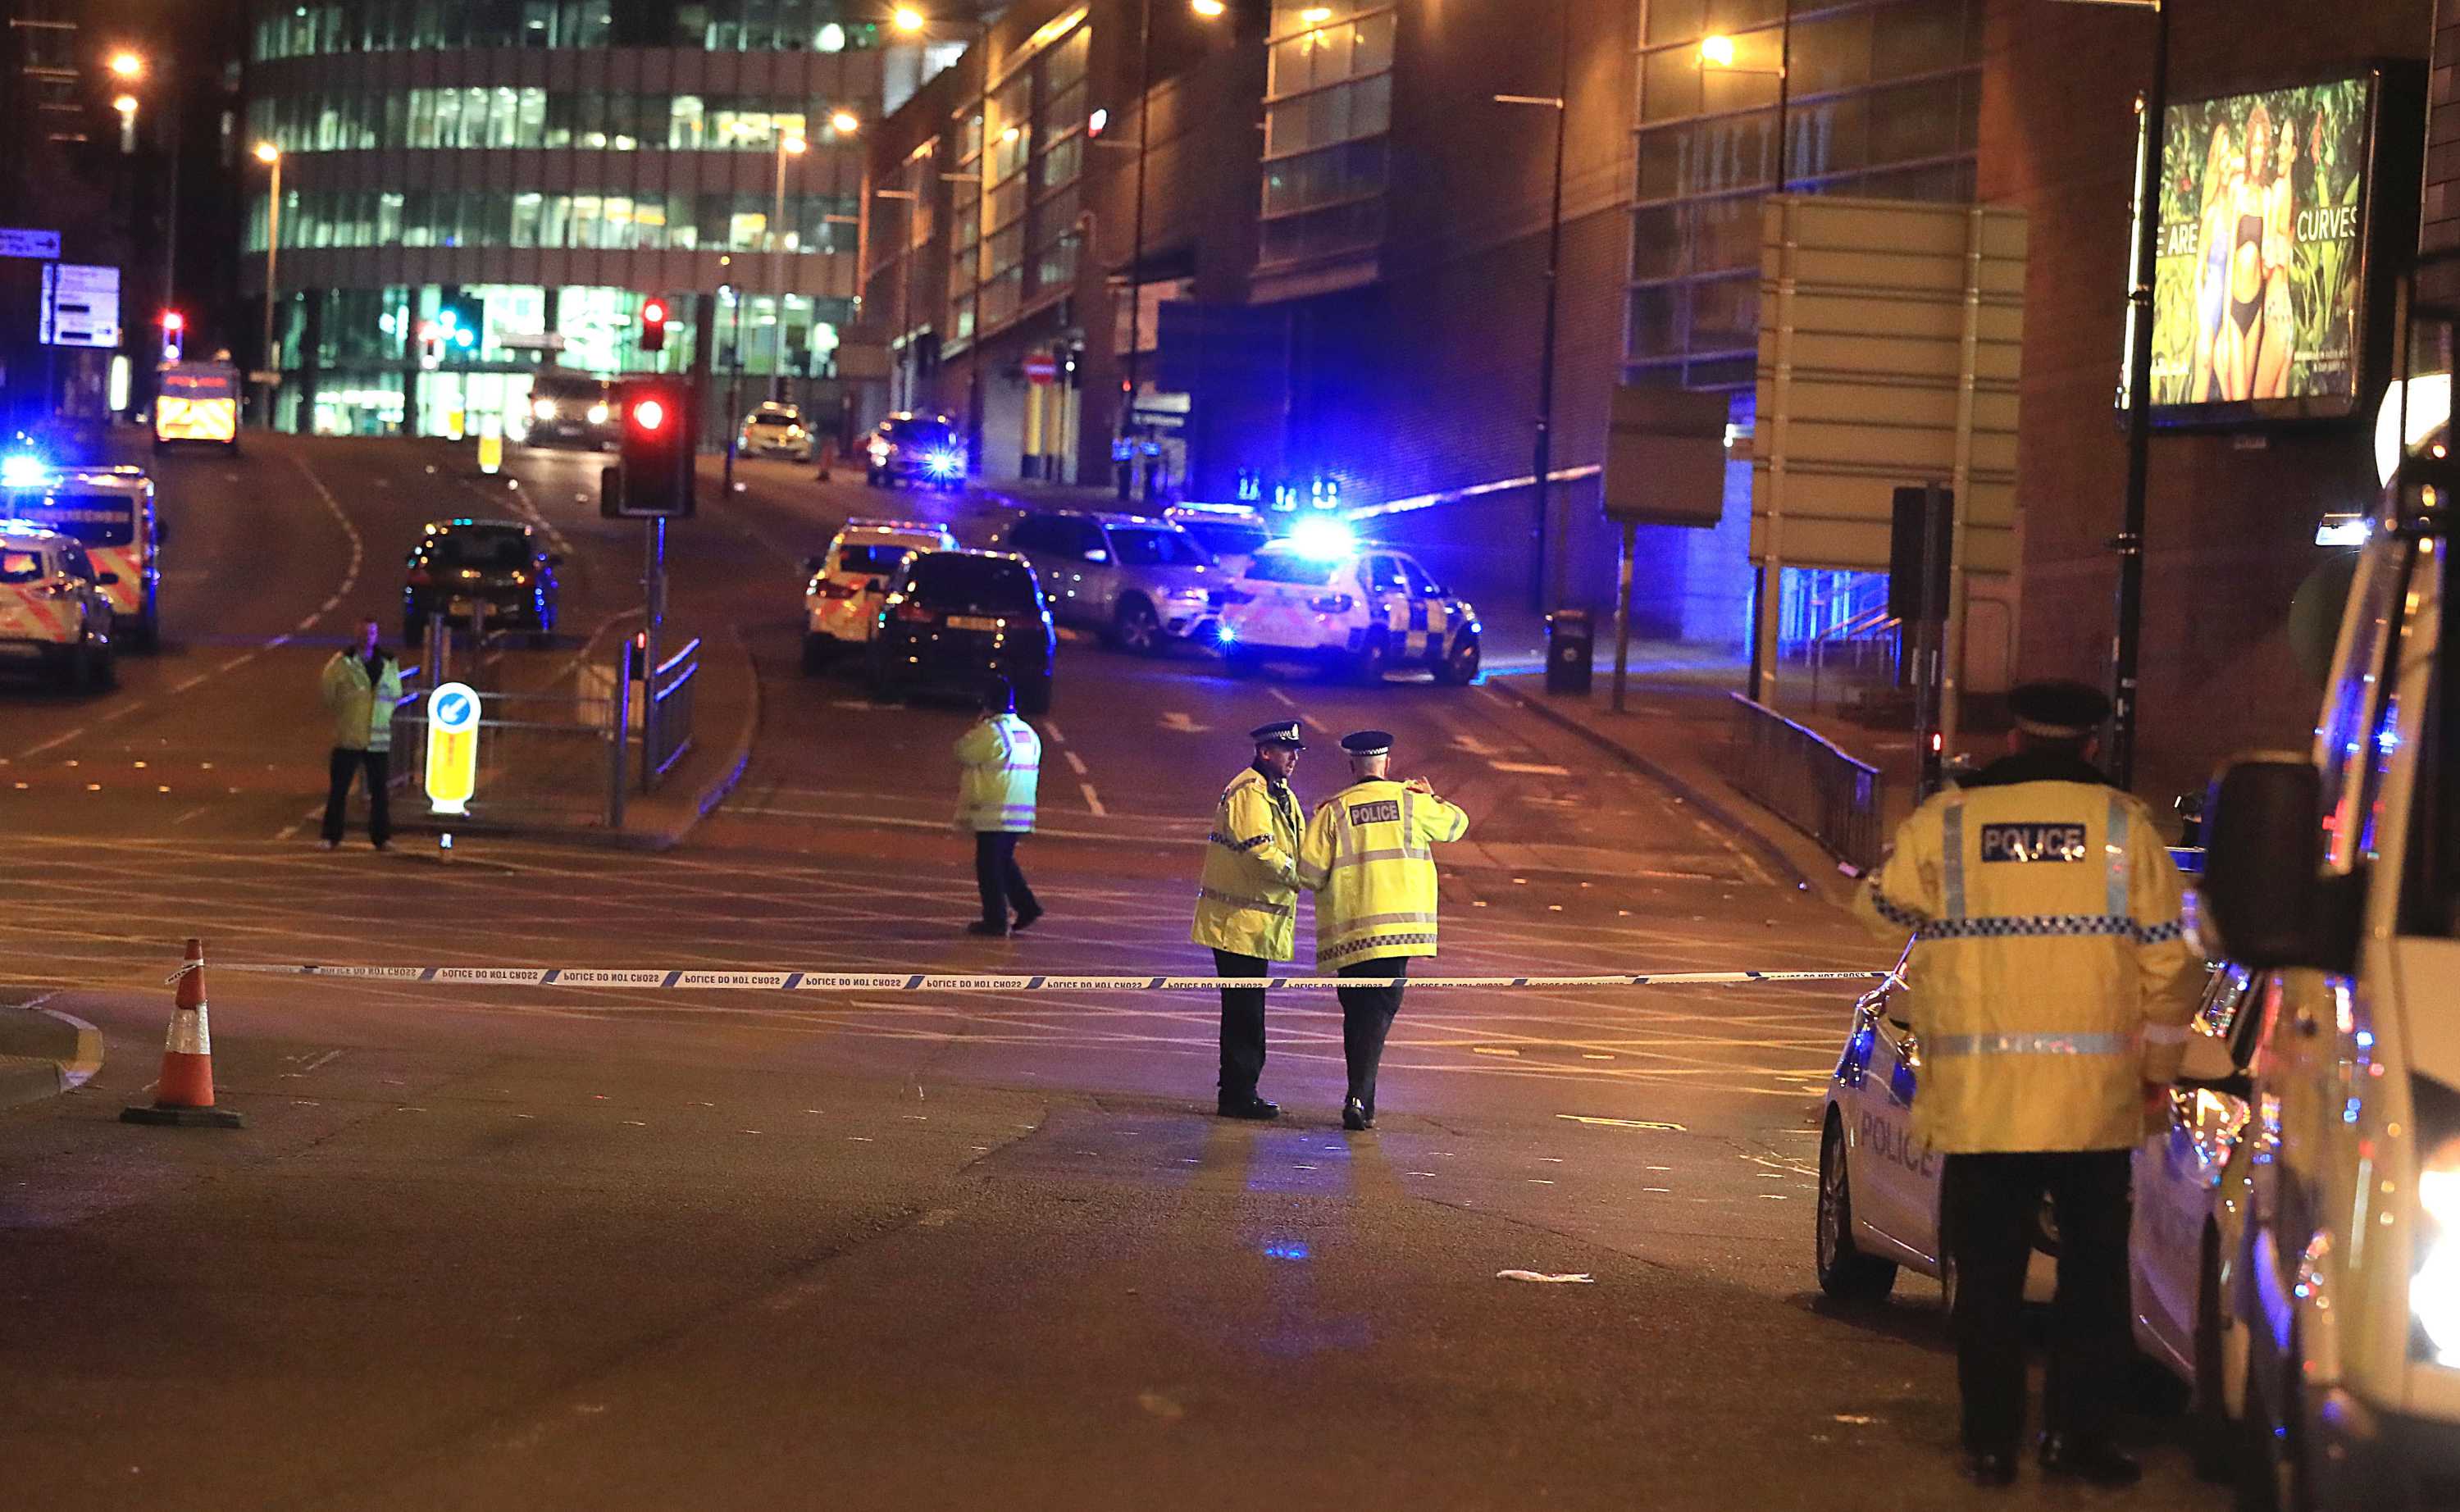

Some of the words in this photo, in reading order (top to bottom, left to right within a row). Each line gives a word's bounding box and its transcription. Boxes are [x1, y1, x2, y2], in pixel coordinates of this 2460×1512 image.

[2167, 223, 2198, 256] ARE
[1351, 804, 1398, 825] POLICE
[1985, 829, 2081, 857] POLICE
[1862, 1112, 1933, 1177] POLICE
